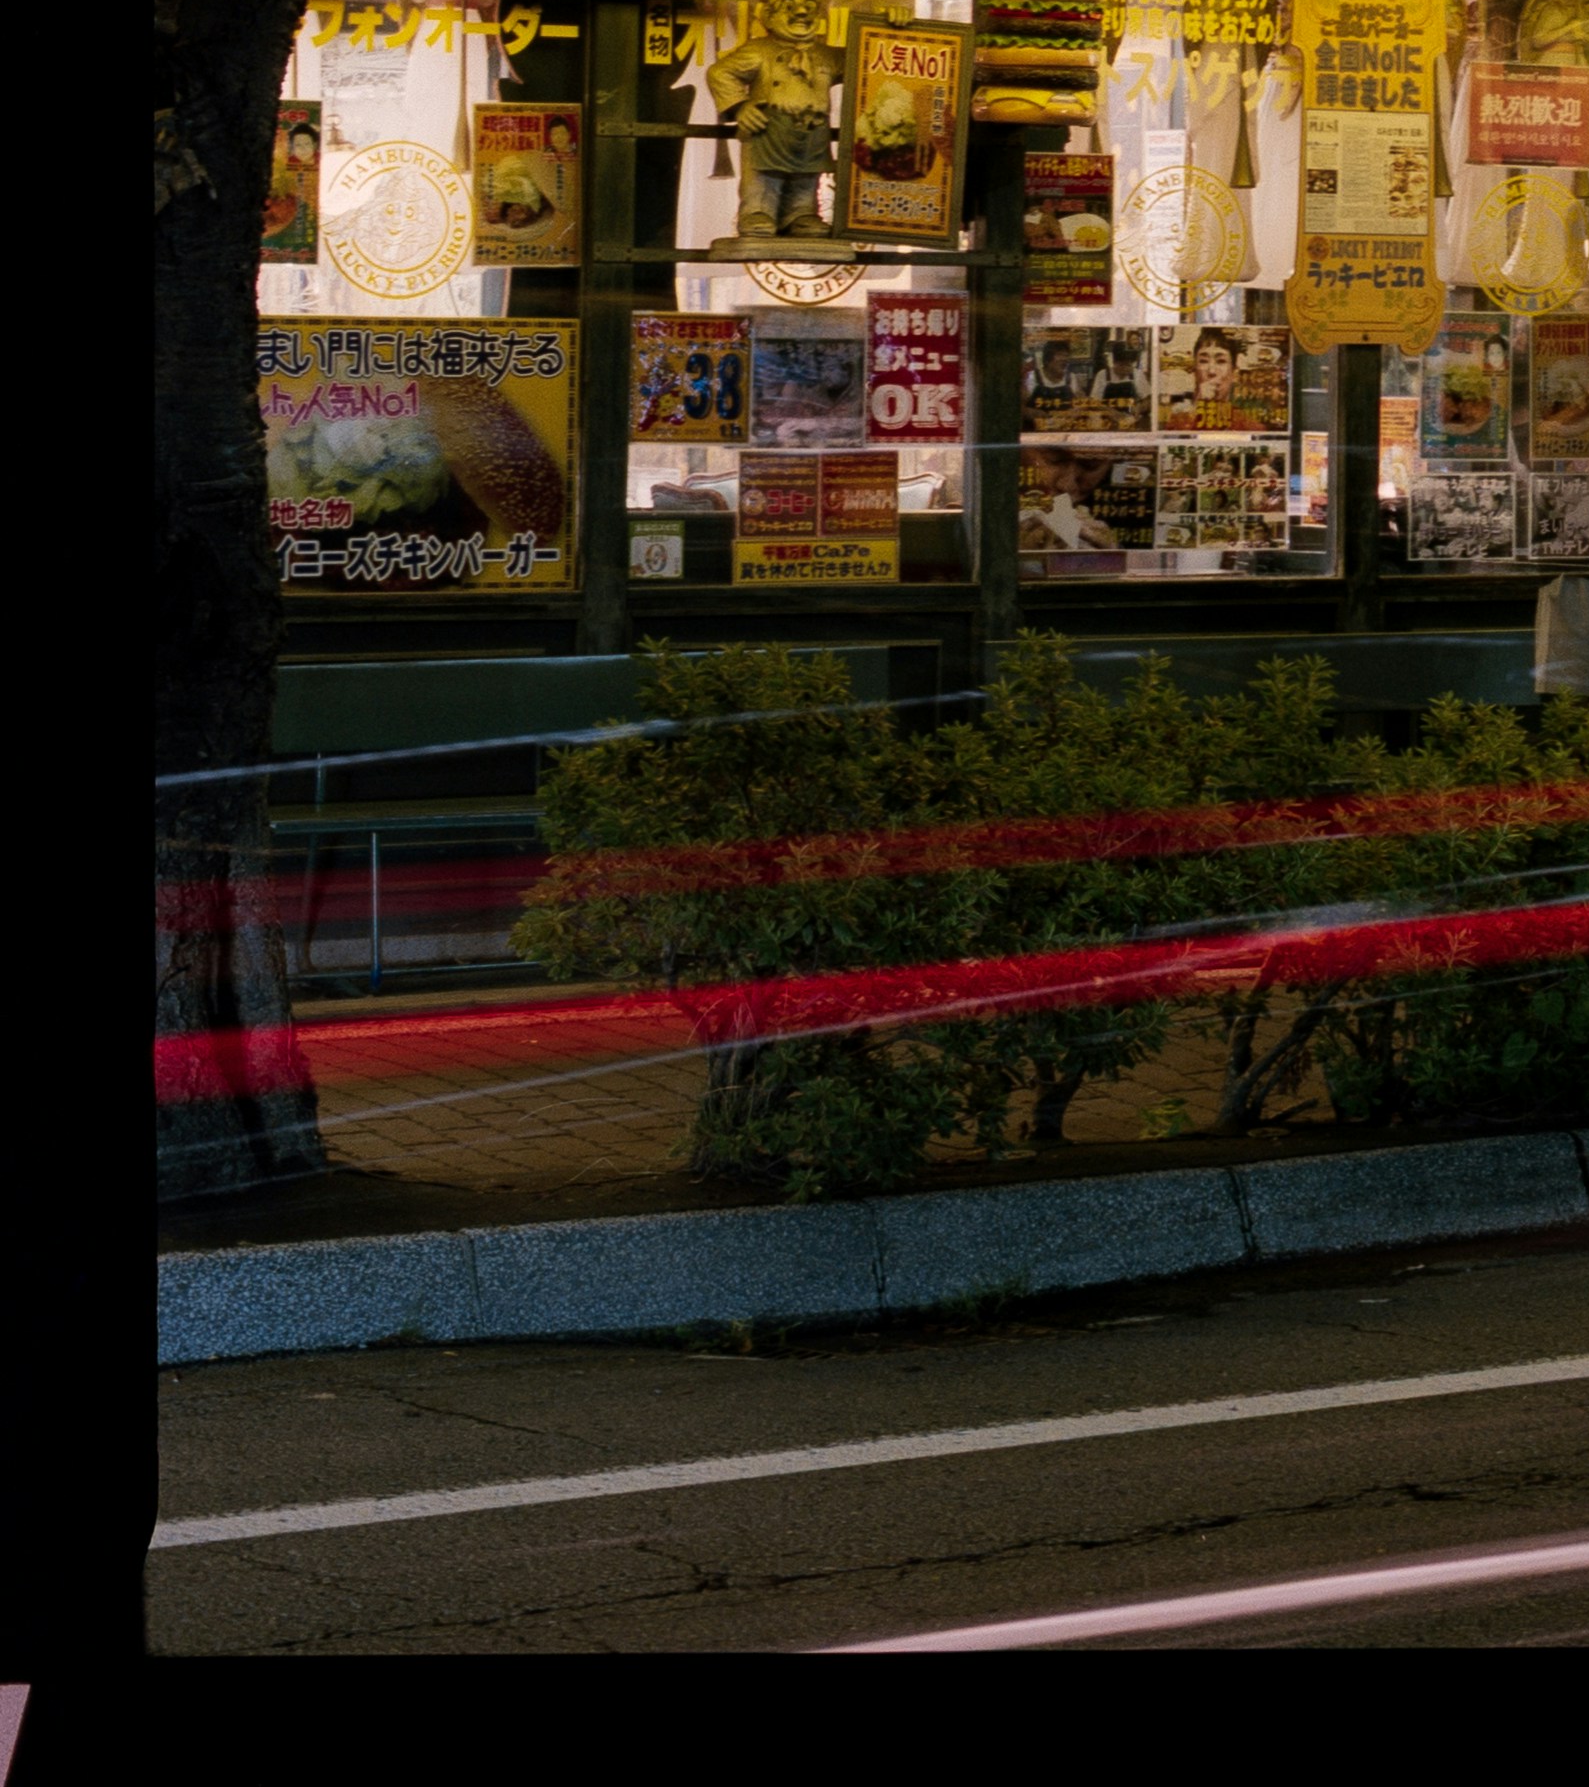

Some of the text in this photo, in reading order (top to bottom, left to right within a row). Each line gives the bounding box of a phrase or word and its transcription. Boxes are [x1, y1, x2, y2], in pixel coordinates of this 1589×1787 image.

[870, 41, 950, 82] 人気No1
[1314, 38, 1423, 74] 全国No1に
[1315, 73, 1422, 109] 輝きました
[340, 146, 460, 197] HAMBURGER
[335, 210, 468, 296] LUCKY PIERROT
[754, 260, 804, 299] UCKY
[1306, 262, 1426, 290] ラッキーピエロ
[873, 308, 960, 337] お持ち帰り
[256, 328, 567, 388] まい門には福来たる
[870, 383, 961, 431] OK
[269, 497, 355, 530] 地名物
[275, 530, 562, 583] イニーズチキンバーガー
